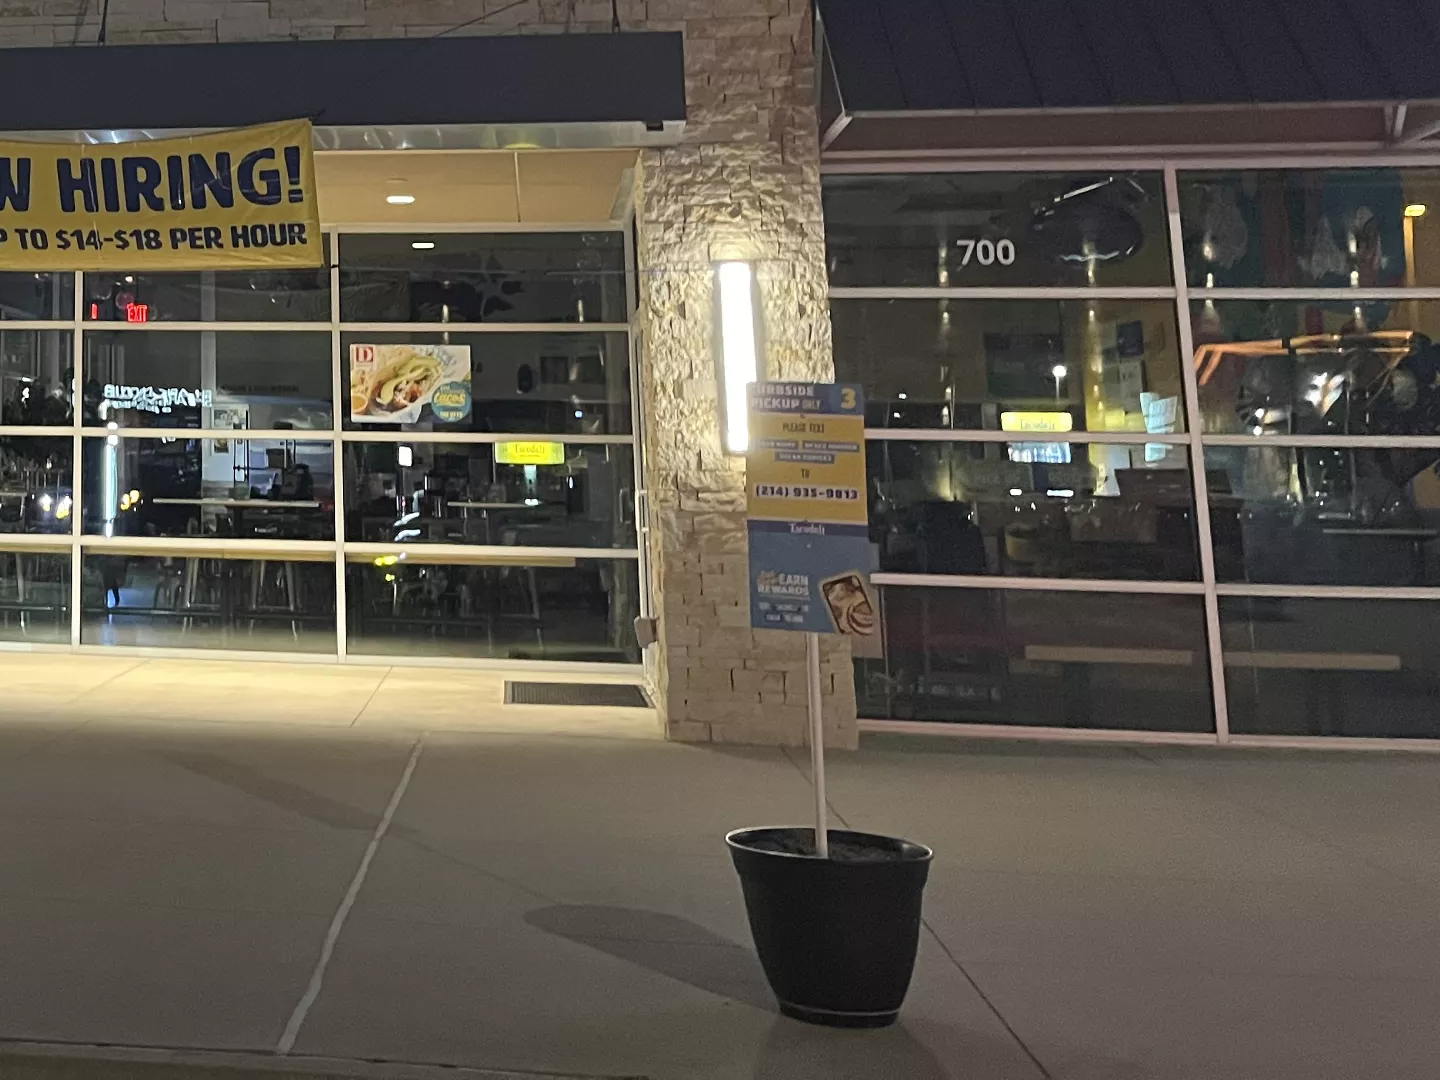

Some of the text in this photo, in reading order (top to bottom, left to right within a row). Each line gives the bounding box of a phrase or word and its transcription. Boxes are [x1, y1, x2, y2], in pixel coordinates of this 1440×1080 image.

[56, 145, 304, 213] HIRING!
[15, 228, 49, 250] TO
[56, 226, 163, 252] $14-$18
[170, 226, 224, 250] PER
[230, 222, 308, 248] HOUR
[956, 239, 1016, 266] 700
[126, 304, 148, 322] EXIT
[751, 397, 800, 409] PICKUP
[840, 387, 857, 409] 3
[782, 423, 806, 433] PLEASE
[755, 485, 789, 497] (214)
